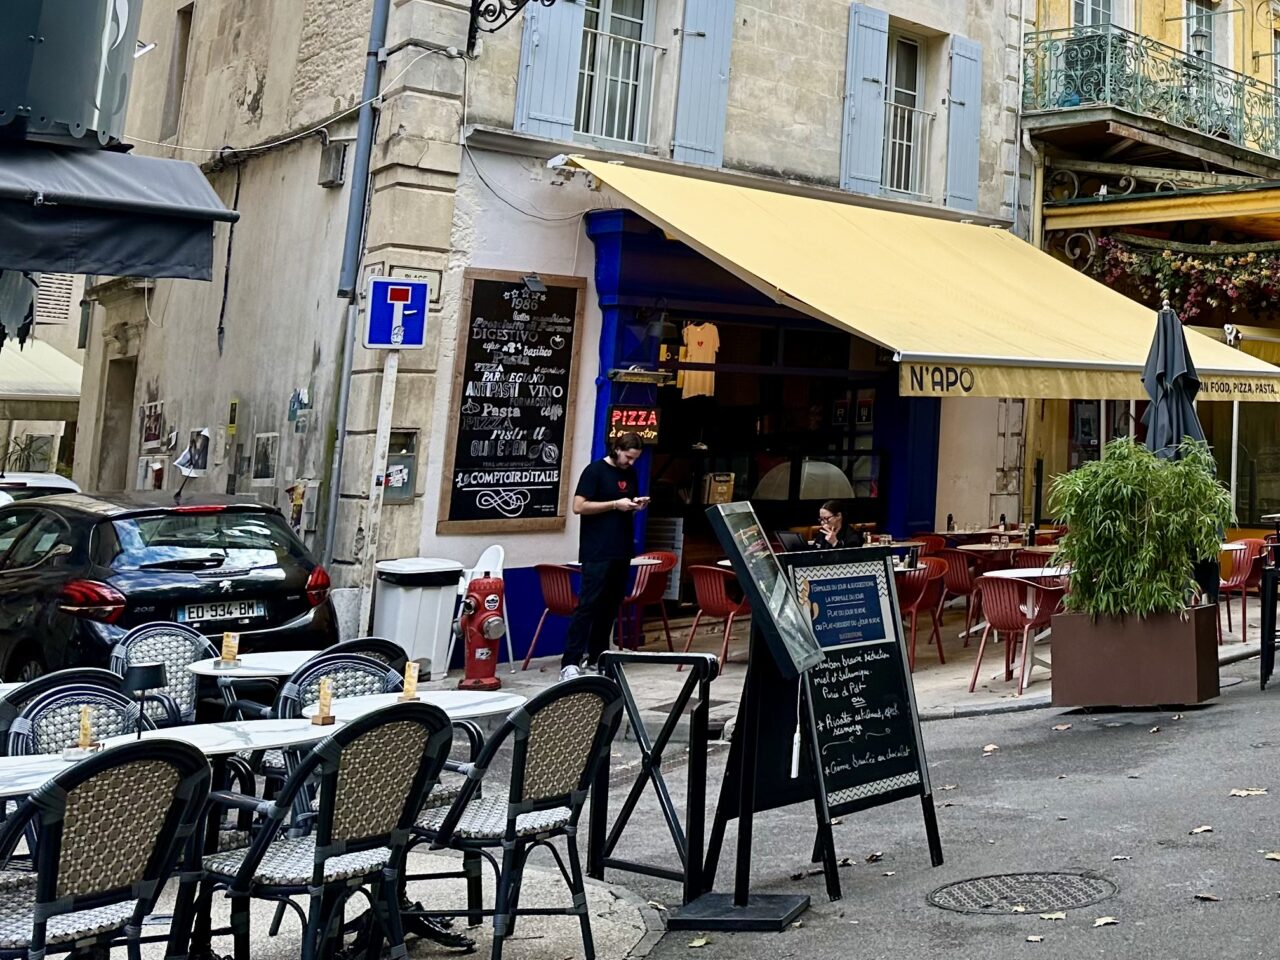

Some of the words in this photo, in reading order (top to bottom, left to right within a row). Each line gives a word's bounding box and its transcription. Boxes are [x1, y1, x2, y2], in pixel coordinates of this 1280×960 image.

[511, 298, 539, 310] 1986
[472, 328, 539, 343] DIGESTIVO
[492, 351, 530, 366] Pasta
[523, 345, 553, 357] basilico
[474, 362, 504, 372] PIZZA
[910, 366, 975, 393] N'APO
[465, 381, 519, 398] ANTIPASTI
[529, 384, 563, 398] VINO
[1210, 382, 1232, 394] FOOD,
[1233, 383, 1255, 395] PIZZA,
[481, 402, 521, 417] Pasta
[462, 416, 513, 430] PIZZA
[612, 410, 657, 426] PIZZA
[455, 471, 471, 488] Le
[470, 471, 522, 485] COMPTOIR
[522, 470, 559, 483] D'ITALIE
[827, 609, 838, 618] PLAT
[813, 671, 830, 686] miel
